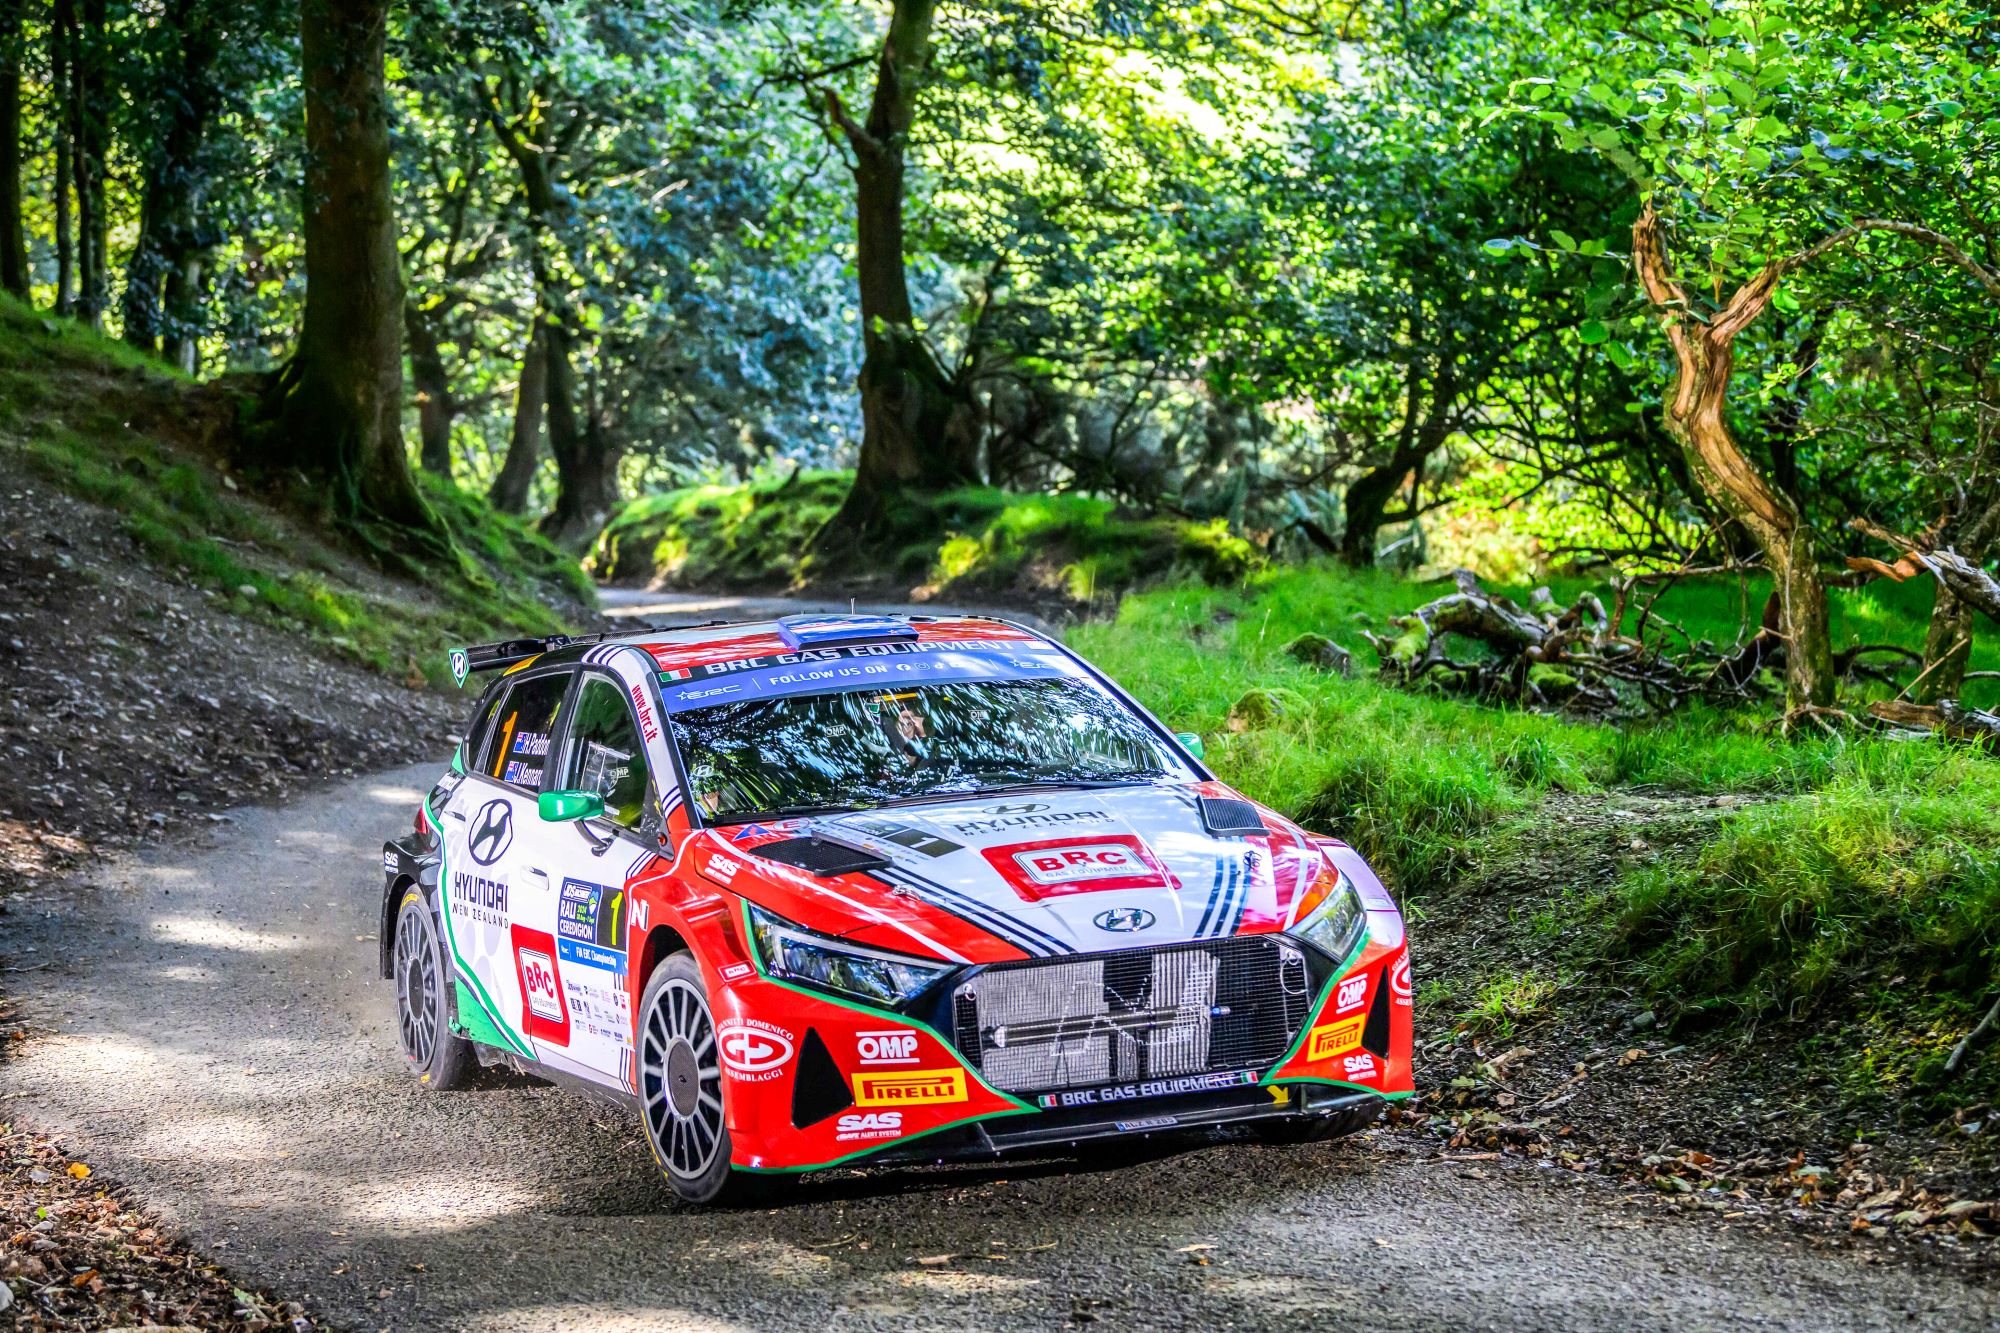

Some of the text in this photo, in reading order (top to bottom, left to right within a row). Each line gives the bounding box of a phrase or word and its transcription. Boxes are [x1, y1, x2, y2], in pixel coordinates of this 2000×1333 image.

[705, 640, 1015, 675] BRC GAS EQUIPMENT
[769, 665, 888, 686] FOLLOW US ON
[686, 684, 743, 699] ERC
[631, 684, 657, 743] www.brc.it
[494, 711, 518, 777] 1
[954, 811, 1110, 832] HYUNDAI
[964, 827, 1006, 836] NEW
[910, 836, 939, 849] 1
[385, 851, 398, 866] SAS
[708, 854, 740, 876] SAS
[1031, 851, 1127, 871] BRC
[1046, 870, 1068, 878] GAS
[454, 871, 508, 912] HYUNDAI
[453, 903, 508, 929] NEW ZEALAND
[560, 900, 577, 919] RALI
[611, 892, 623, 945] 1
[631, 898, 649, 931] N
[560, 919, 593, 939] CEREDIGION
[526, 961, 554, 999] BRC
[1338, 979, 1367, 1008] OMP
[746, 1018, 794, 1041] DOMENICO
[1315, 1022, 1360, 1053] PIRELLI
[857, 1036, 918, 1059] OMP
[1343, 1053, 1375, 1073] SAS
[862, 1076, 955, 1100] PIRELLI
[1061, 1074, 1236, 1105] BRC GAS EQUIPMENT
[836, 1112, 903, 1131] SAS
[879, 1130, 901, 1138] SYSTEM
